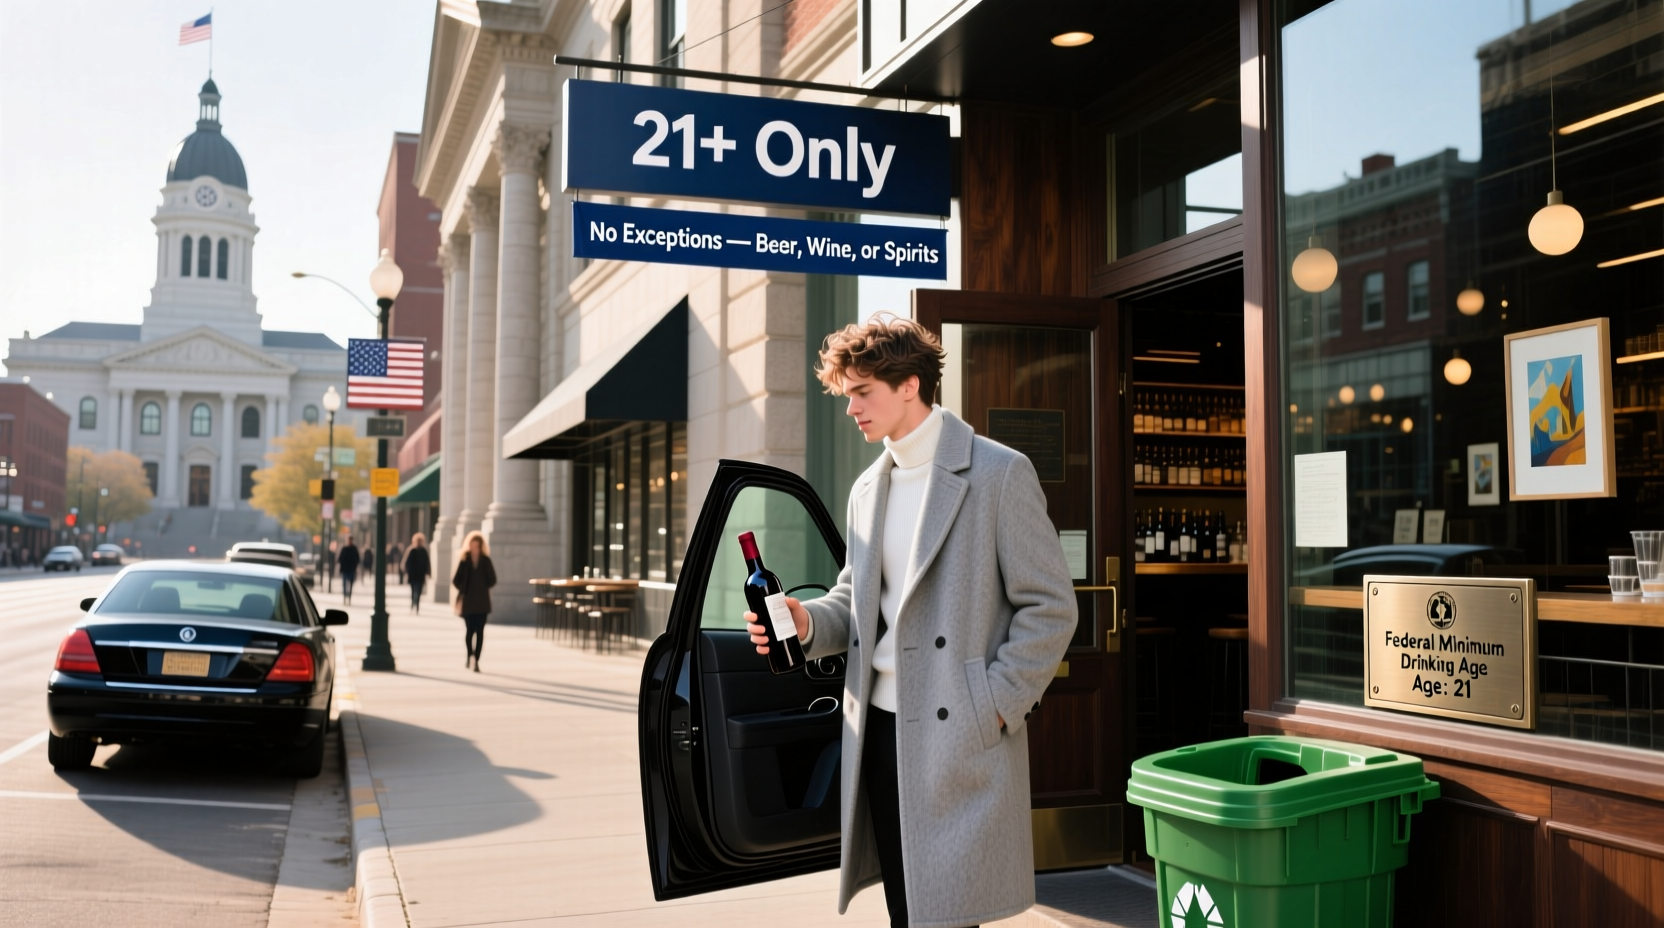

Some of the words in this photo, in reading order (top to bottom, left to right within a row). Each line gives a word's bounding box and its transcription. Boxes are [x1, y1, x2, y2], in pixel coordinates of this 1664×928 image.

[632, 110, 737, 170] 21+
[755, 120, 897, 199] Only
[590, 221, 618, 243] No
[622, 223, 723, 251] Exceptions
[755, 233, 803, 260] Beer,
[806, 236, 857, 262] Wine,
[861, 243, 880, 259] or
[884, 242, 940, 267] Spirits
[1385, 631, 1435, 650] Federal
[1458, 656, 1488, 680] Age
[1412, 674, 1448, 698] Age:
[1453, 679, 1472, 699] 21
